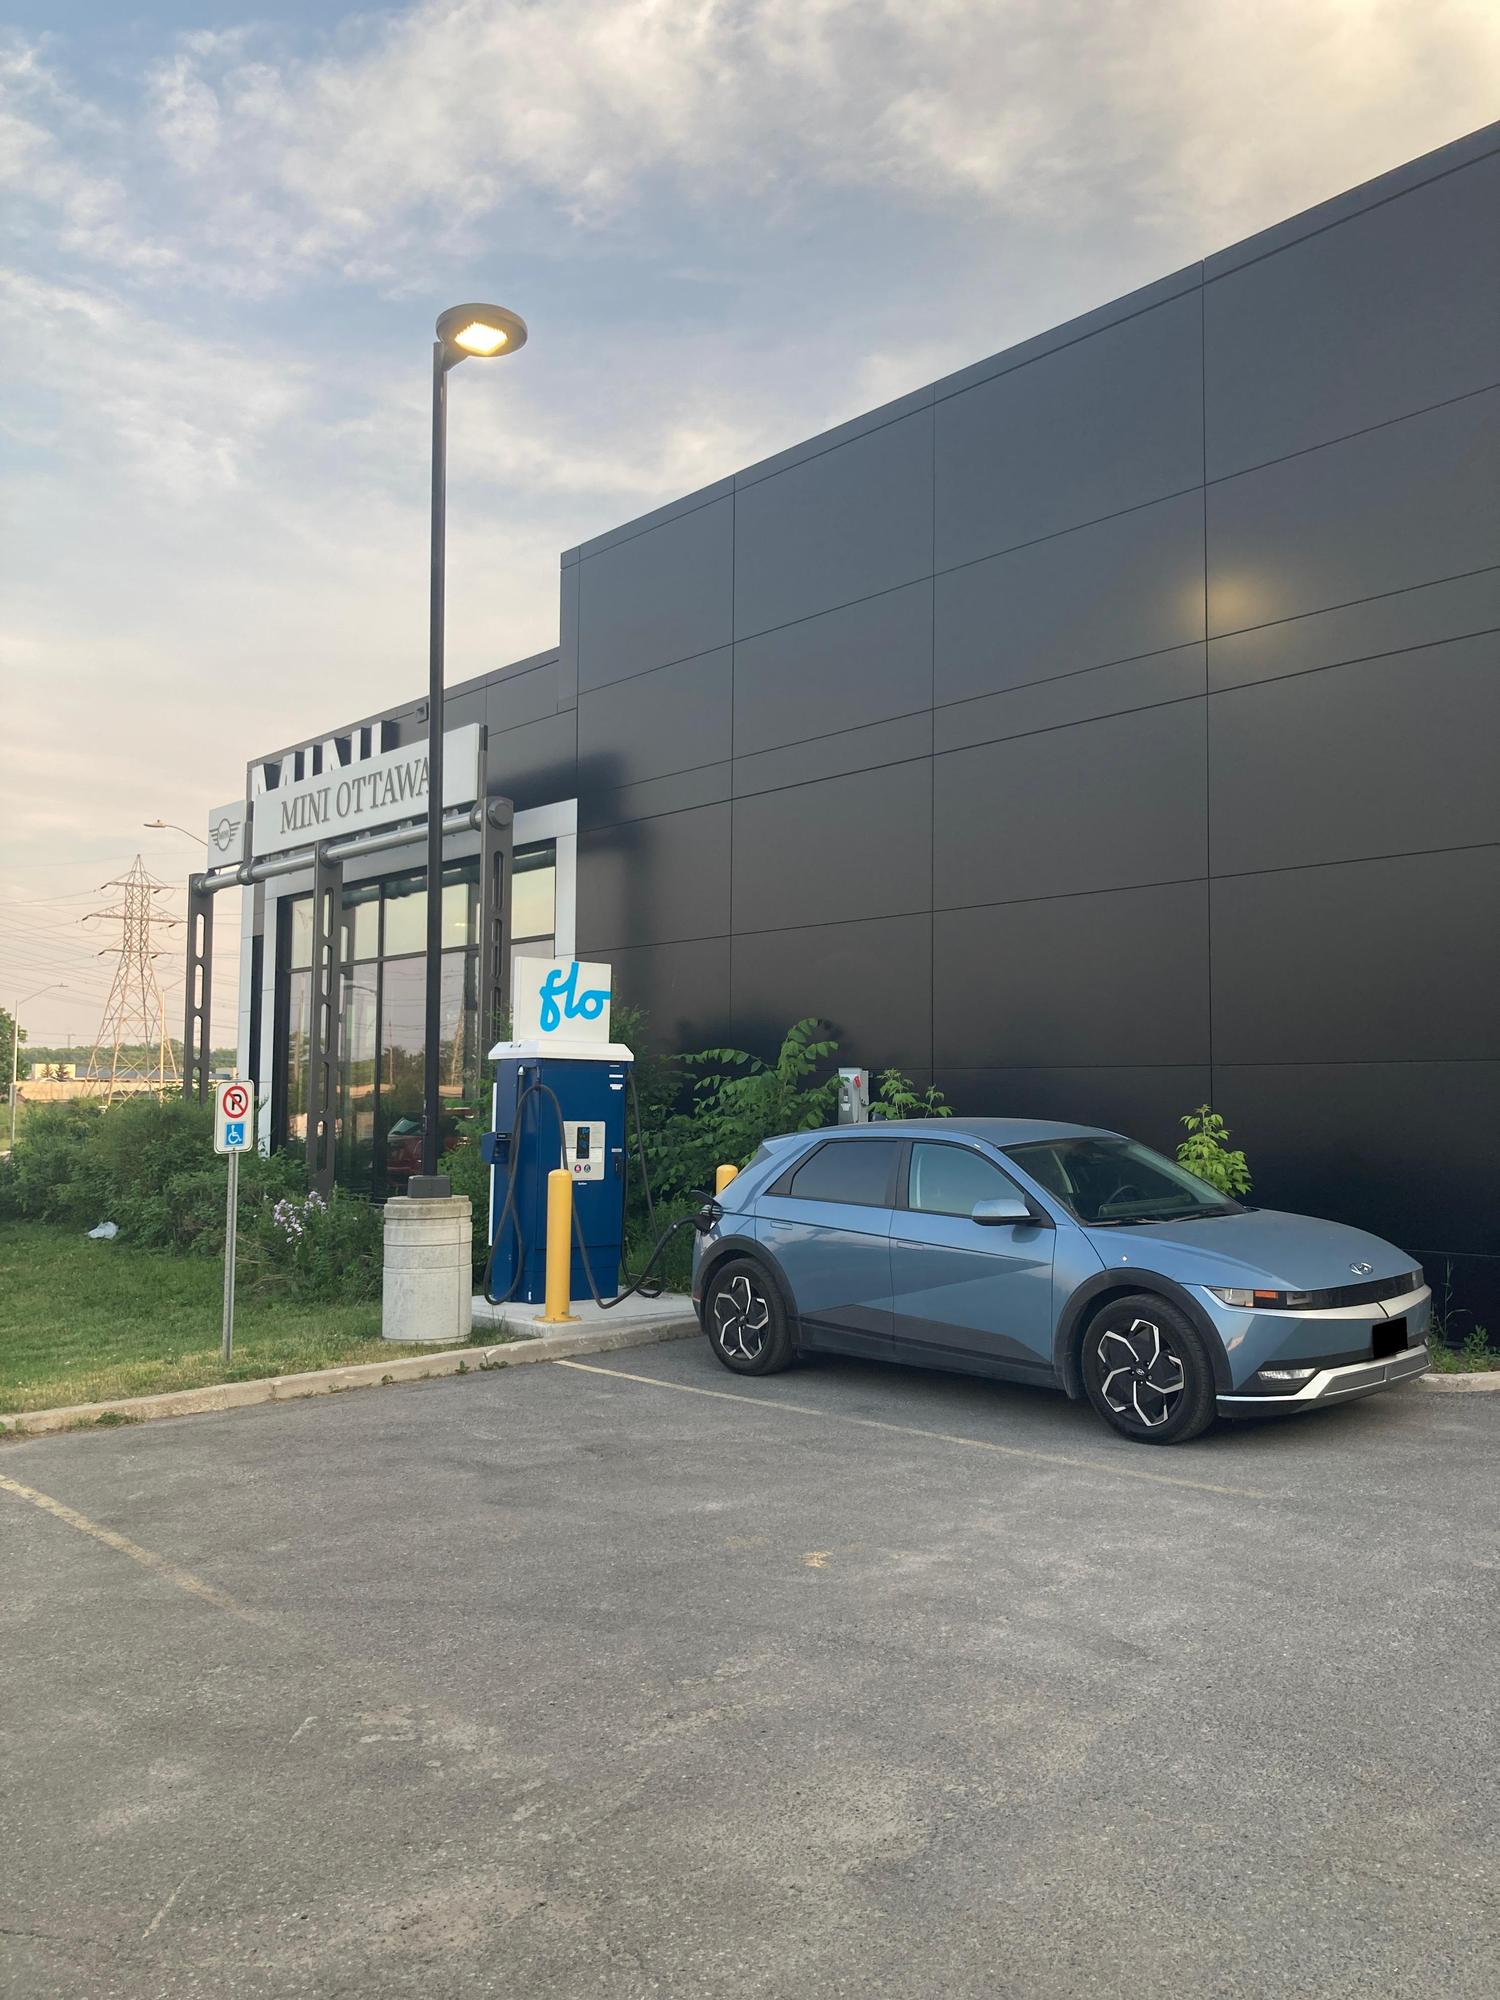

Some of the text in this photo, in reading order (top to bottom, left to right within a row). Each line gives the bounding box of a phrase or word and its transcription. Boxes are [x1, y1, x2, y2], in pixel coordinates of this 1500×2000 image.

[280, 756, 430, 834] MINI OTTAWA
[539, 960, 612, 1032] flo
